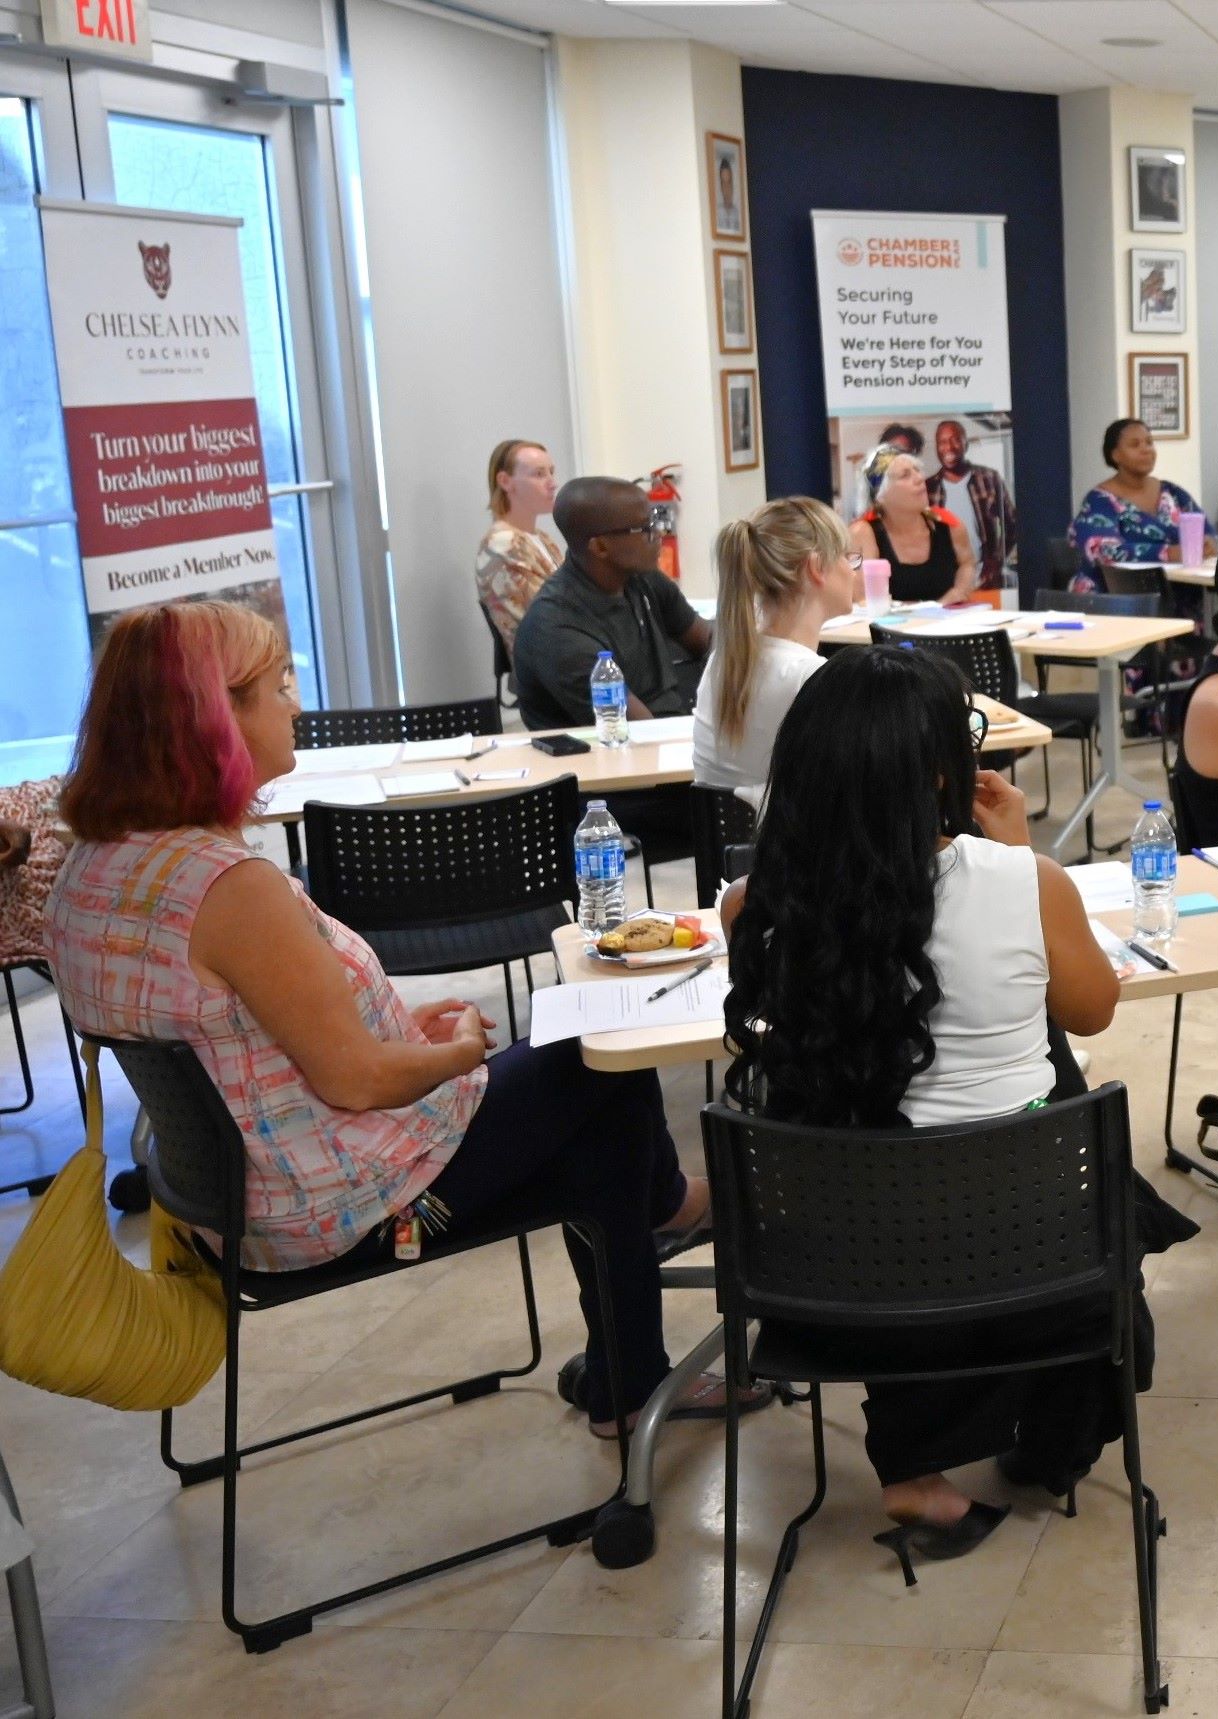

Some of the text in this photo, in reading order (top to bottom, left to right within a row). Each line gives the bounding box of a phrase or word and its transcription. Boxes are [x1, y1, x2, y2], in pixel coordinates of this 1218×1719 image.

[867, 238, 950, 250] CHAMBER
[869, 254, 951, 268] PENSION
[837, 287, 913, 305] Securing
[85, 312, 240, 338] CHELSEA FLYNN
[838, 311, 938, 325] Your Future
[841, 336, 982, 350] We're Here for You
[126, 347, 210, 360] COACHING
[842, 354, 983, 372] Every Step of Your
[843, 373, 970, 388] Pension Journey
[90, 424, 257, 464] Turn your biggest
[97, 459, 260, 494] breakdown into your
[103, 484, 264, 529] biggest breakthrough!
[107, 548, 275, 592] Become a Member Now.
